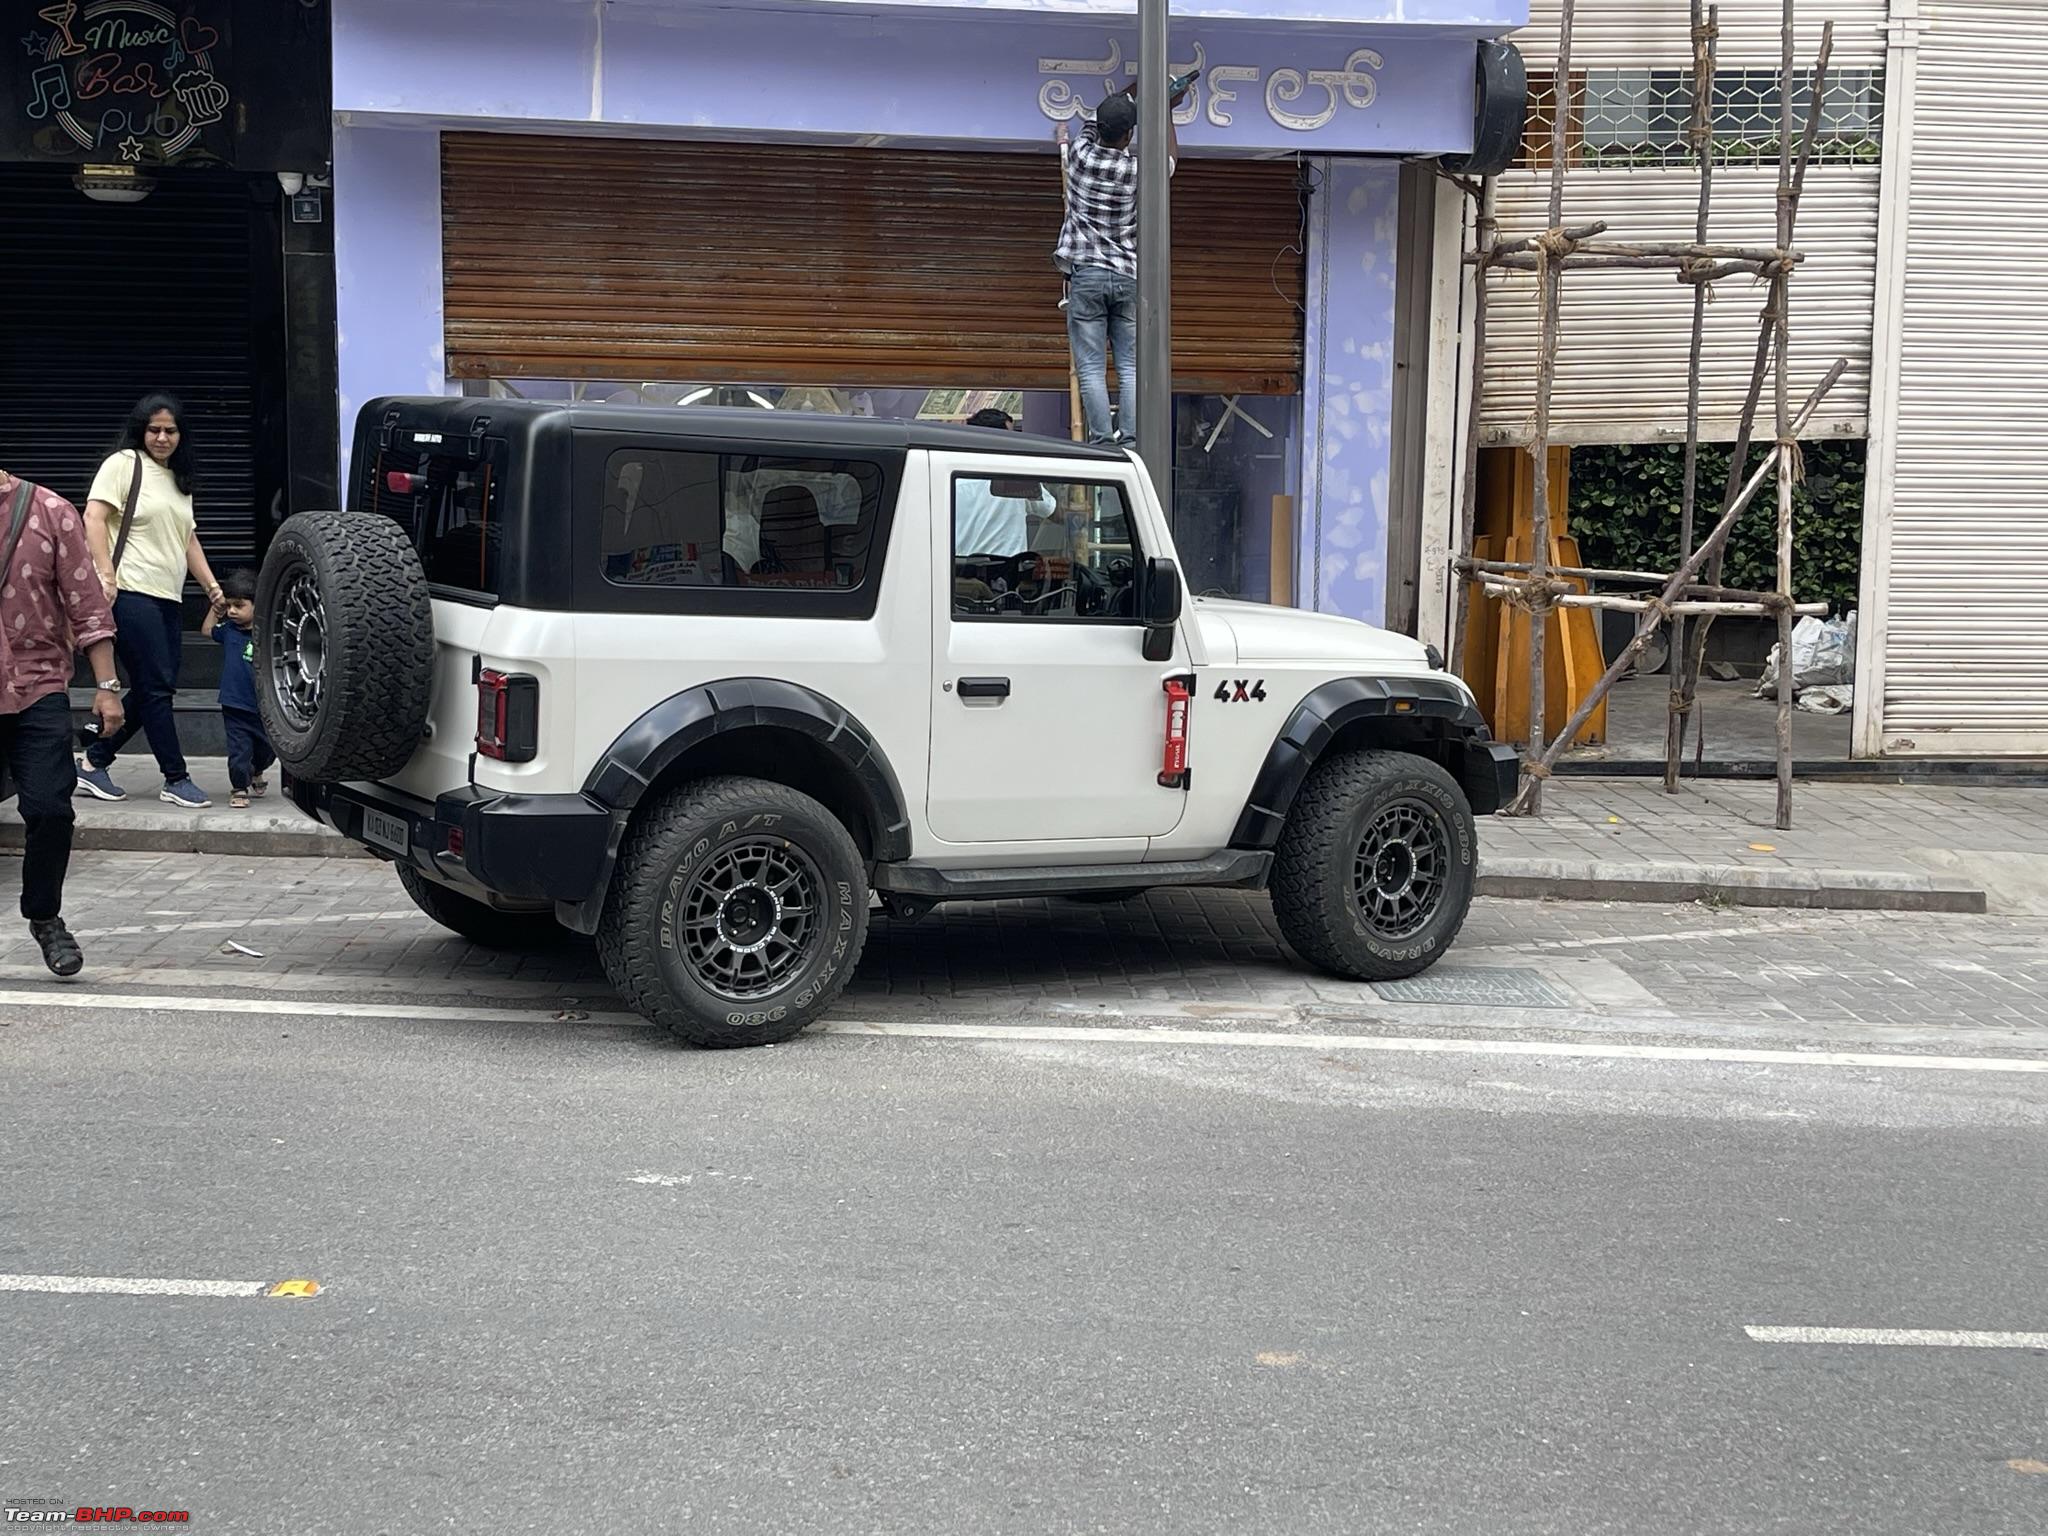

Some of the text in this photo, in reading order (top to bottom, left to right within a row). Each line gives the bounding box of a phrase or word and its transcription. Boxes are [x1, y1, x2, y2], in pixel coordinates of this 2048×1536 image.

[85, 19, 174, 50] Music
[76, 52, 171, 100] Bar
[1213, 679, 1267, 703] 4X4
[660, 814, 782, 949] BRAVO A/T
[726, 881, 853, 1026] MAXXIS 980
[1366, 936, 1436, 961] BRAVO
